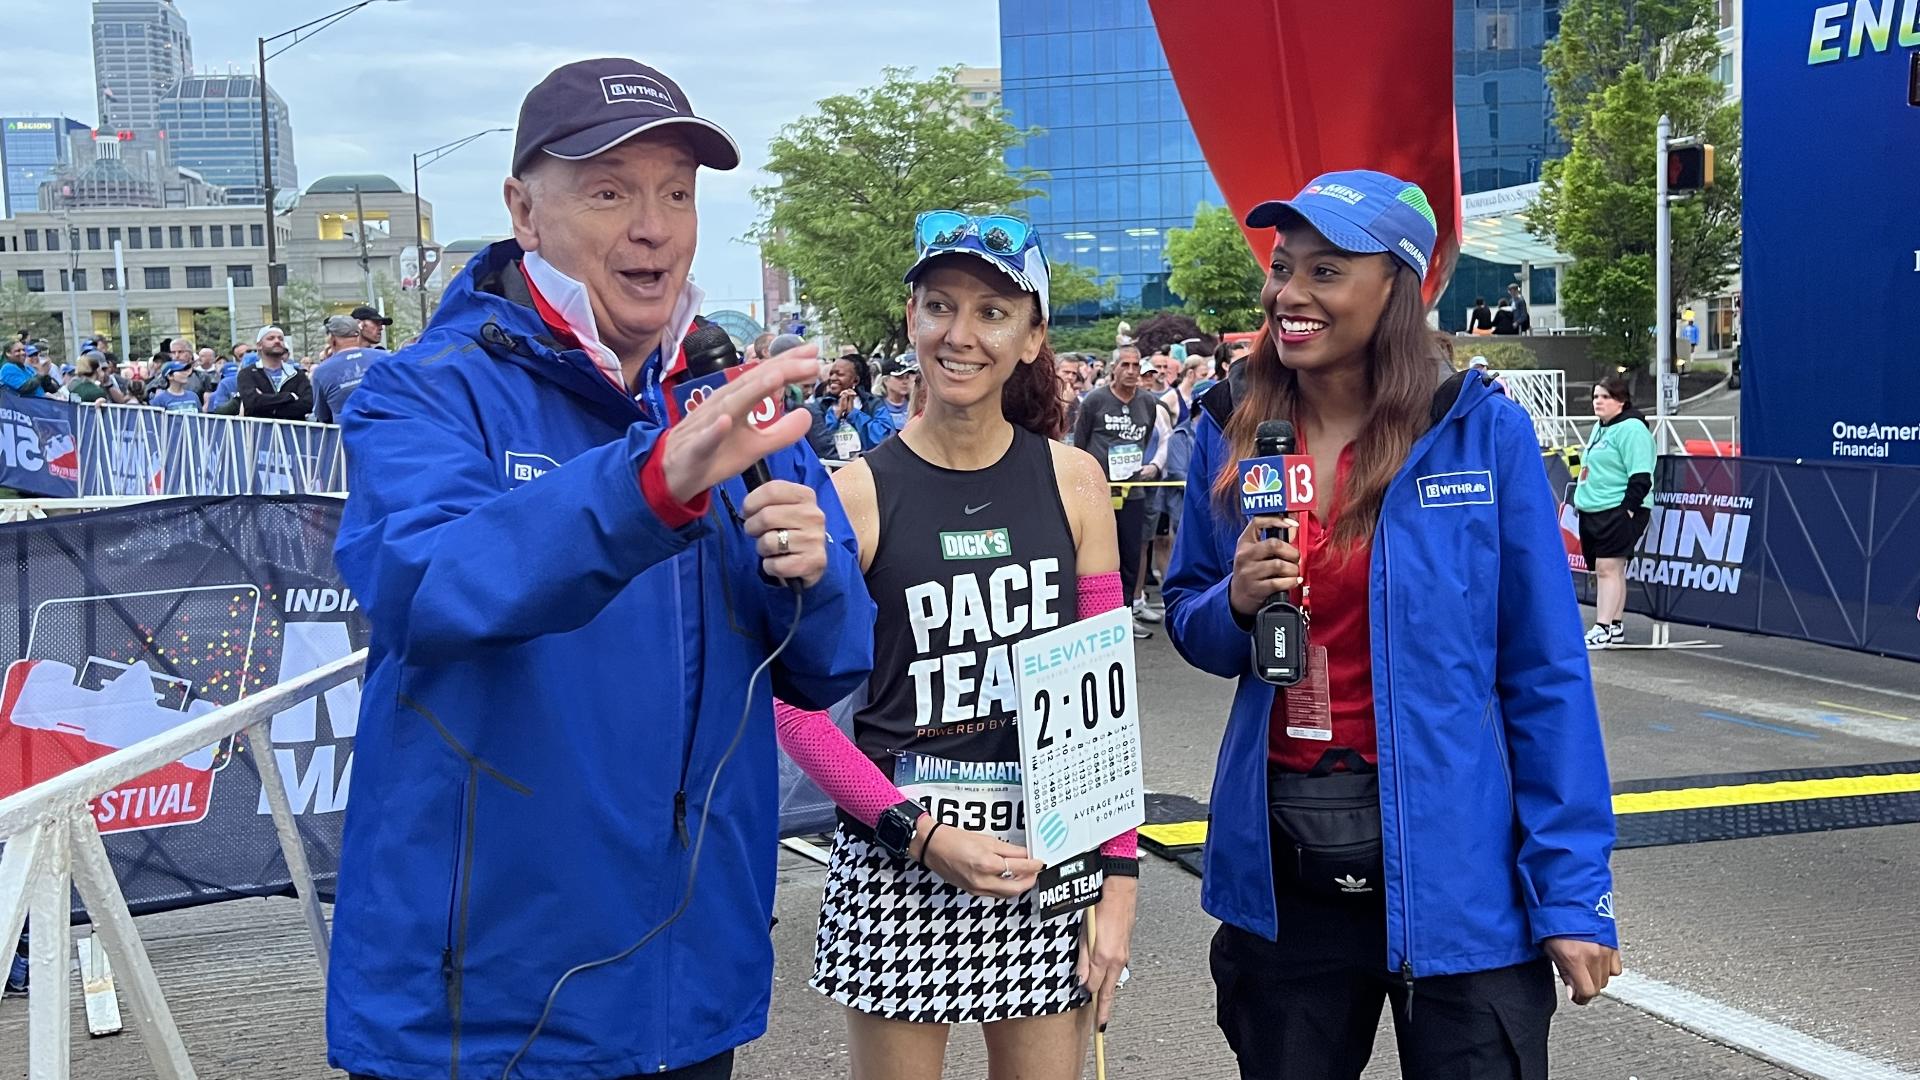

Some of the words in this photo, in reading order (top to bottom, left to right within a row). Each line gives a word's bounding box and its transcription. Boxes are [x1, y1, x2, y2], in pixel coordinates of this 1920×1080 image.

[626, 85, 658, 97] WTHR
[17, 122, 51, 130] REGIONS
[1325, 183, 1366, 202] MINI
[1833, 441, 1889, 458] Financial
[1288, 464, 1314, 504] 13
[1440, 483, 1472, 495] WTHR
[1243, 493, 1283, 509] WTHR
[1655, 493, 1712, 506] UNIVERSITY
[1713, 495, 1753, 509] HEALTH
[944, 532, 1008, 557] DICK'S
[1626, 557, 1741, 594] ARATHON
[905, 558, 1060, 654] PACE
[1025, 625, 1126, 676] ELEVATED
[908, 644, 1017, 727] TEA
[1034, 661, 1126, 751] 2:00
[916, 723, 985, 738] POWERED
[989, 719, 1007, 730] BY
[1047, 750, 1053, 761] 12
[1062, 744, 1068, 755] 10
[915, 755, 1022, 781] MINI-MARATH
[88, 782, 197, 823] STIVAL
[1074, 798, 1111, 821] AVERAGE
[1115, 788, 1135, 800] PACE
[1060, 860, 1084, 877] DICK'S
[1040, 882, 1071, 909] PACE
[1072, 868, 1103, 896] TEAM
